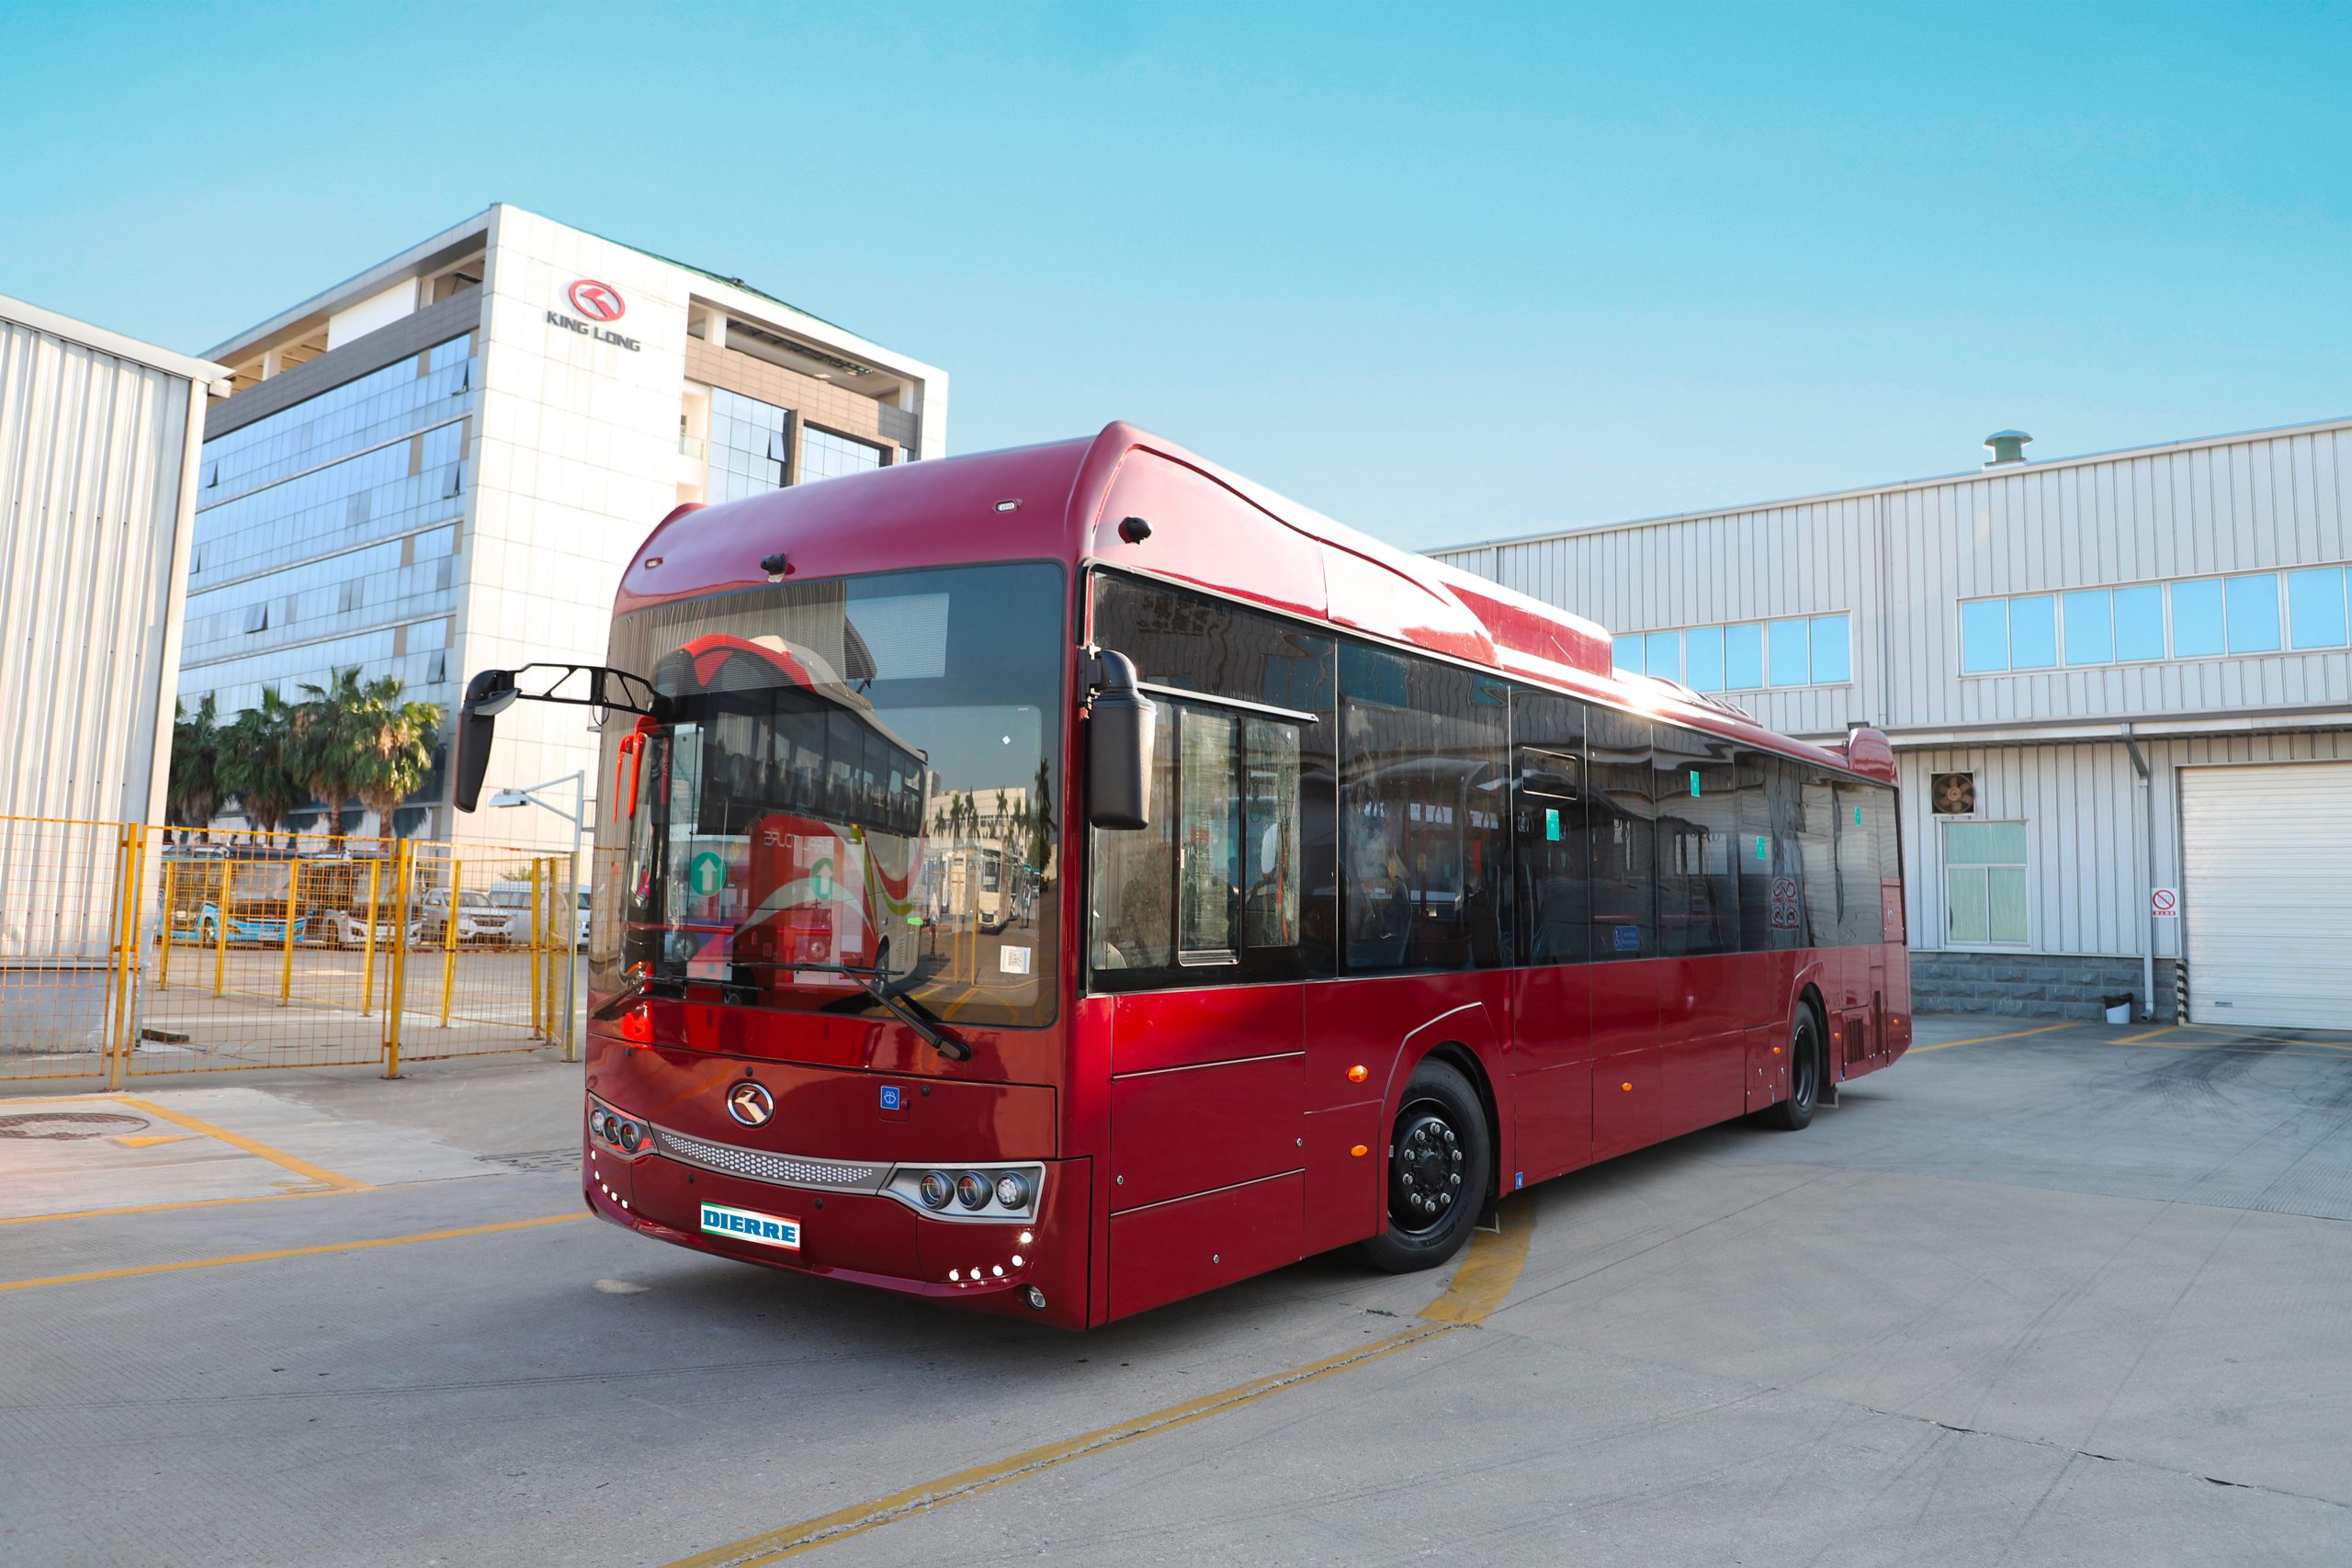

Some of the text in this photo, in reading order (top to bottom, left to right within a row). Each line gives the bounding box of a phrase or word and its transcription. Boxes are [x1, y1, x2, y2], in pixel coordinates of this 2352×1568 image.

[546, 310, 641, 353] KING LONG
[703, 1209, 797, 1243] DIERRE
